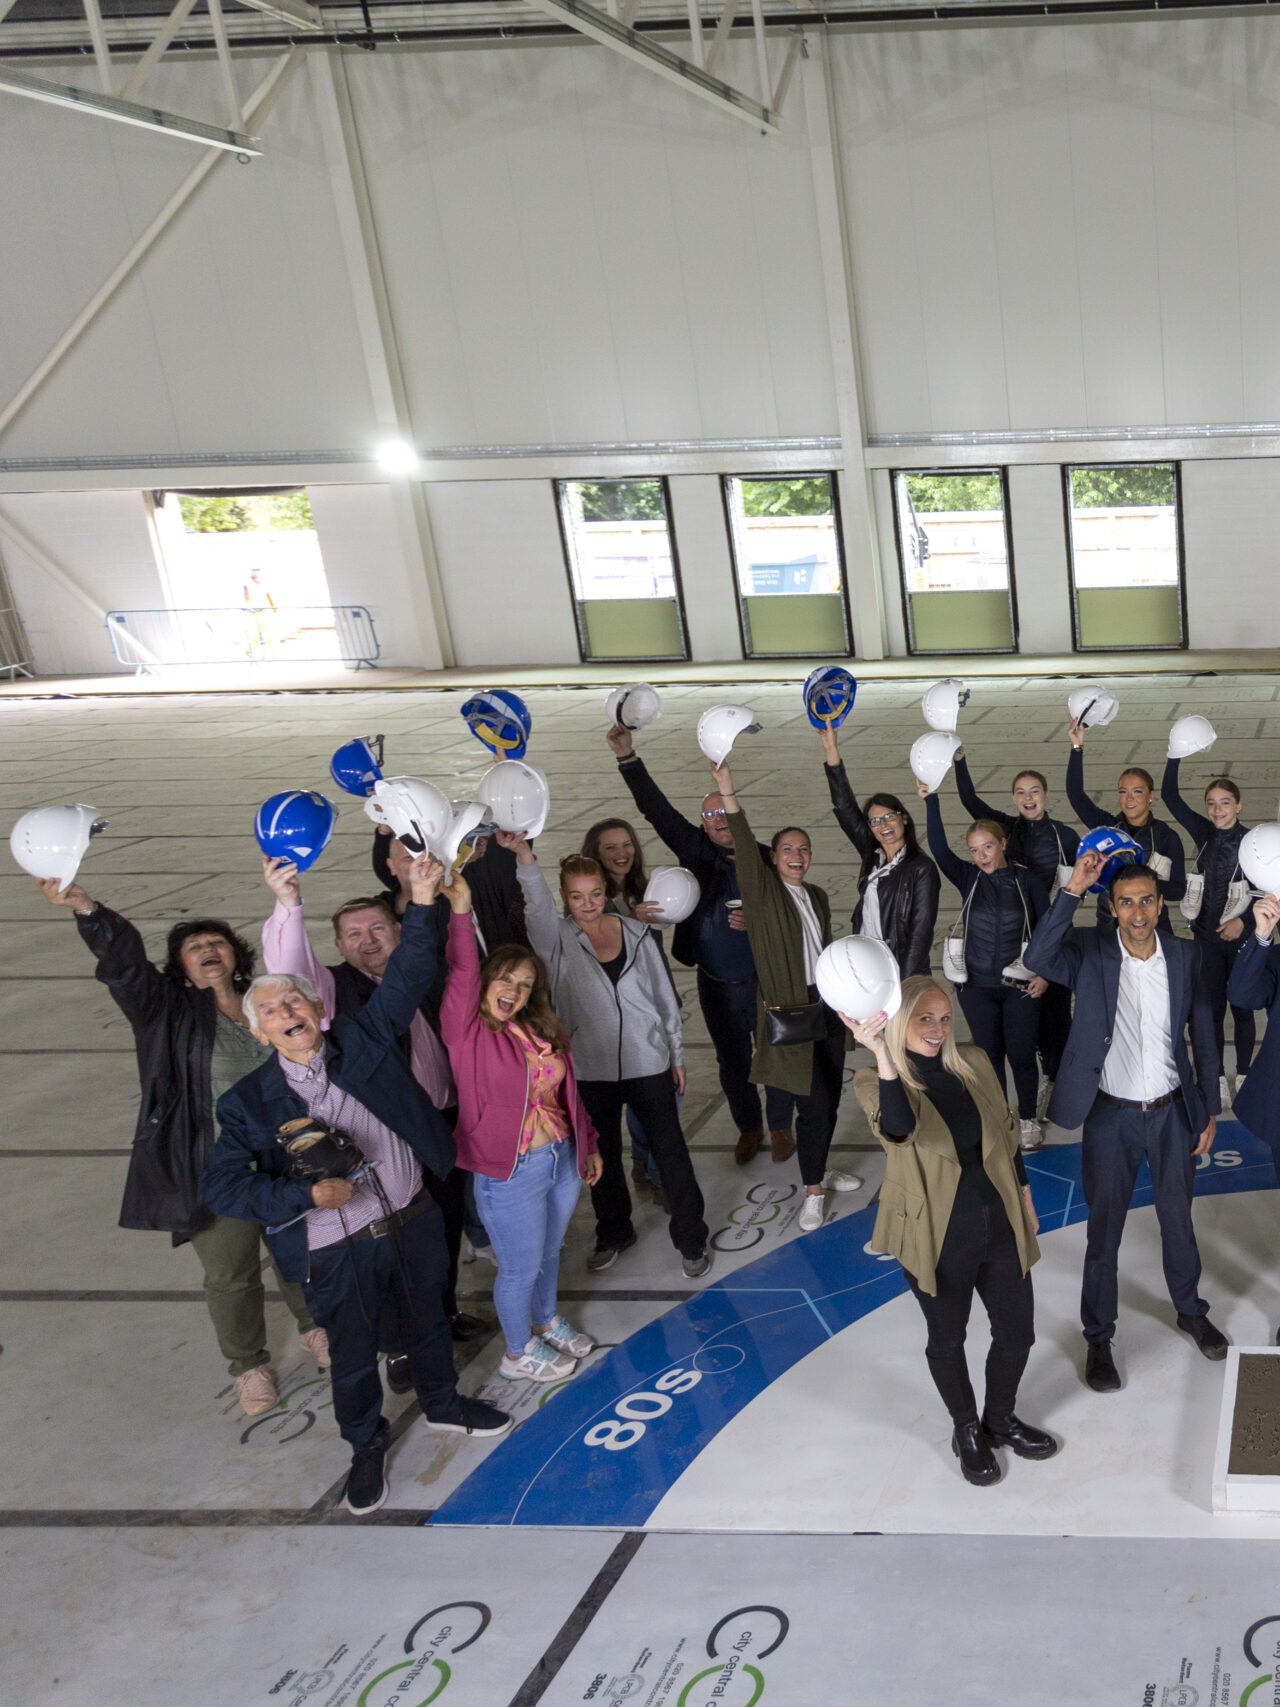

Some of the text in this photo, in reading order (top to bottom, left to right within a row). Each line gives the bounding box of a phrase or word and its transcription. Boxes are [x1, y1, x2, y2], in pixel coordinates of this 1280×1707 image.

[584, 1368, 702, 1451] 80s
[430, 1625, 453, 1648] city
[732, 1630, 753, 1652] city
[268, 1668, 298, 1695] 3806
[396, 1650, 435, 1692] central
[673, 1662, 685, 1676] 020
[710, 1655, 741, 1697] central
[583, 1672, 608, 1701] 3806
[1177, 1689, 1188, 1706] LPCB
[1220, 1672, 1231, 1706] 020 8567
